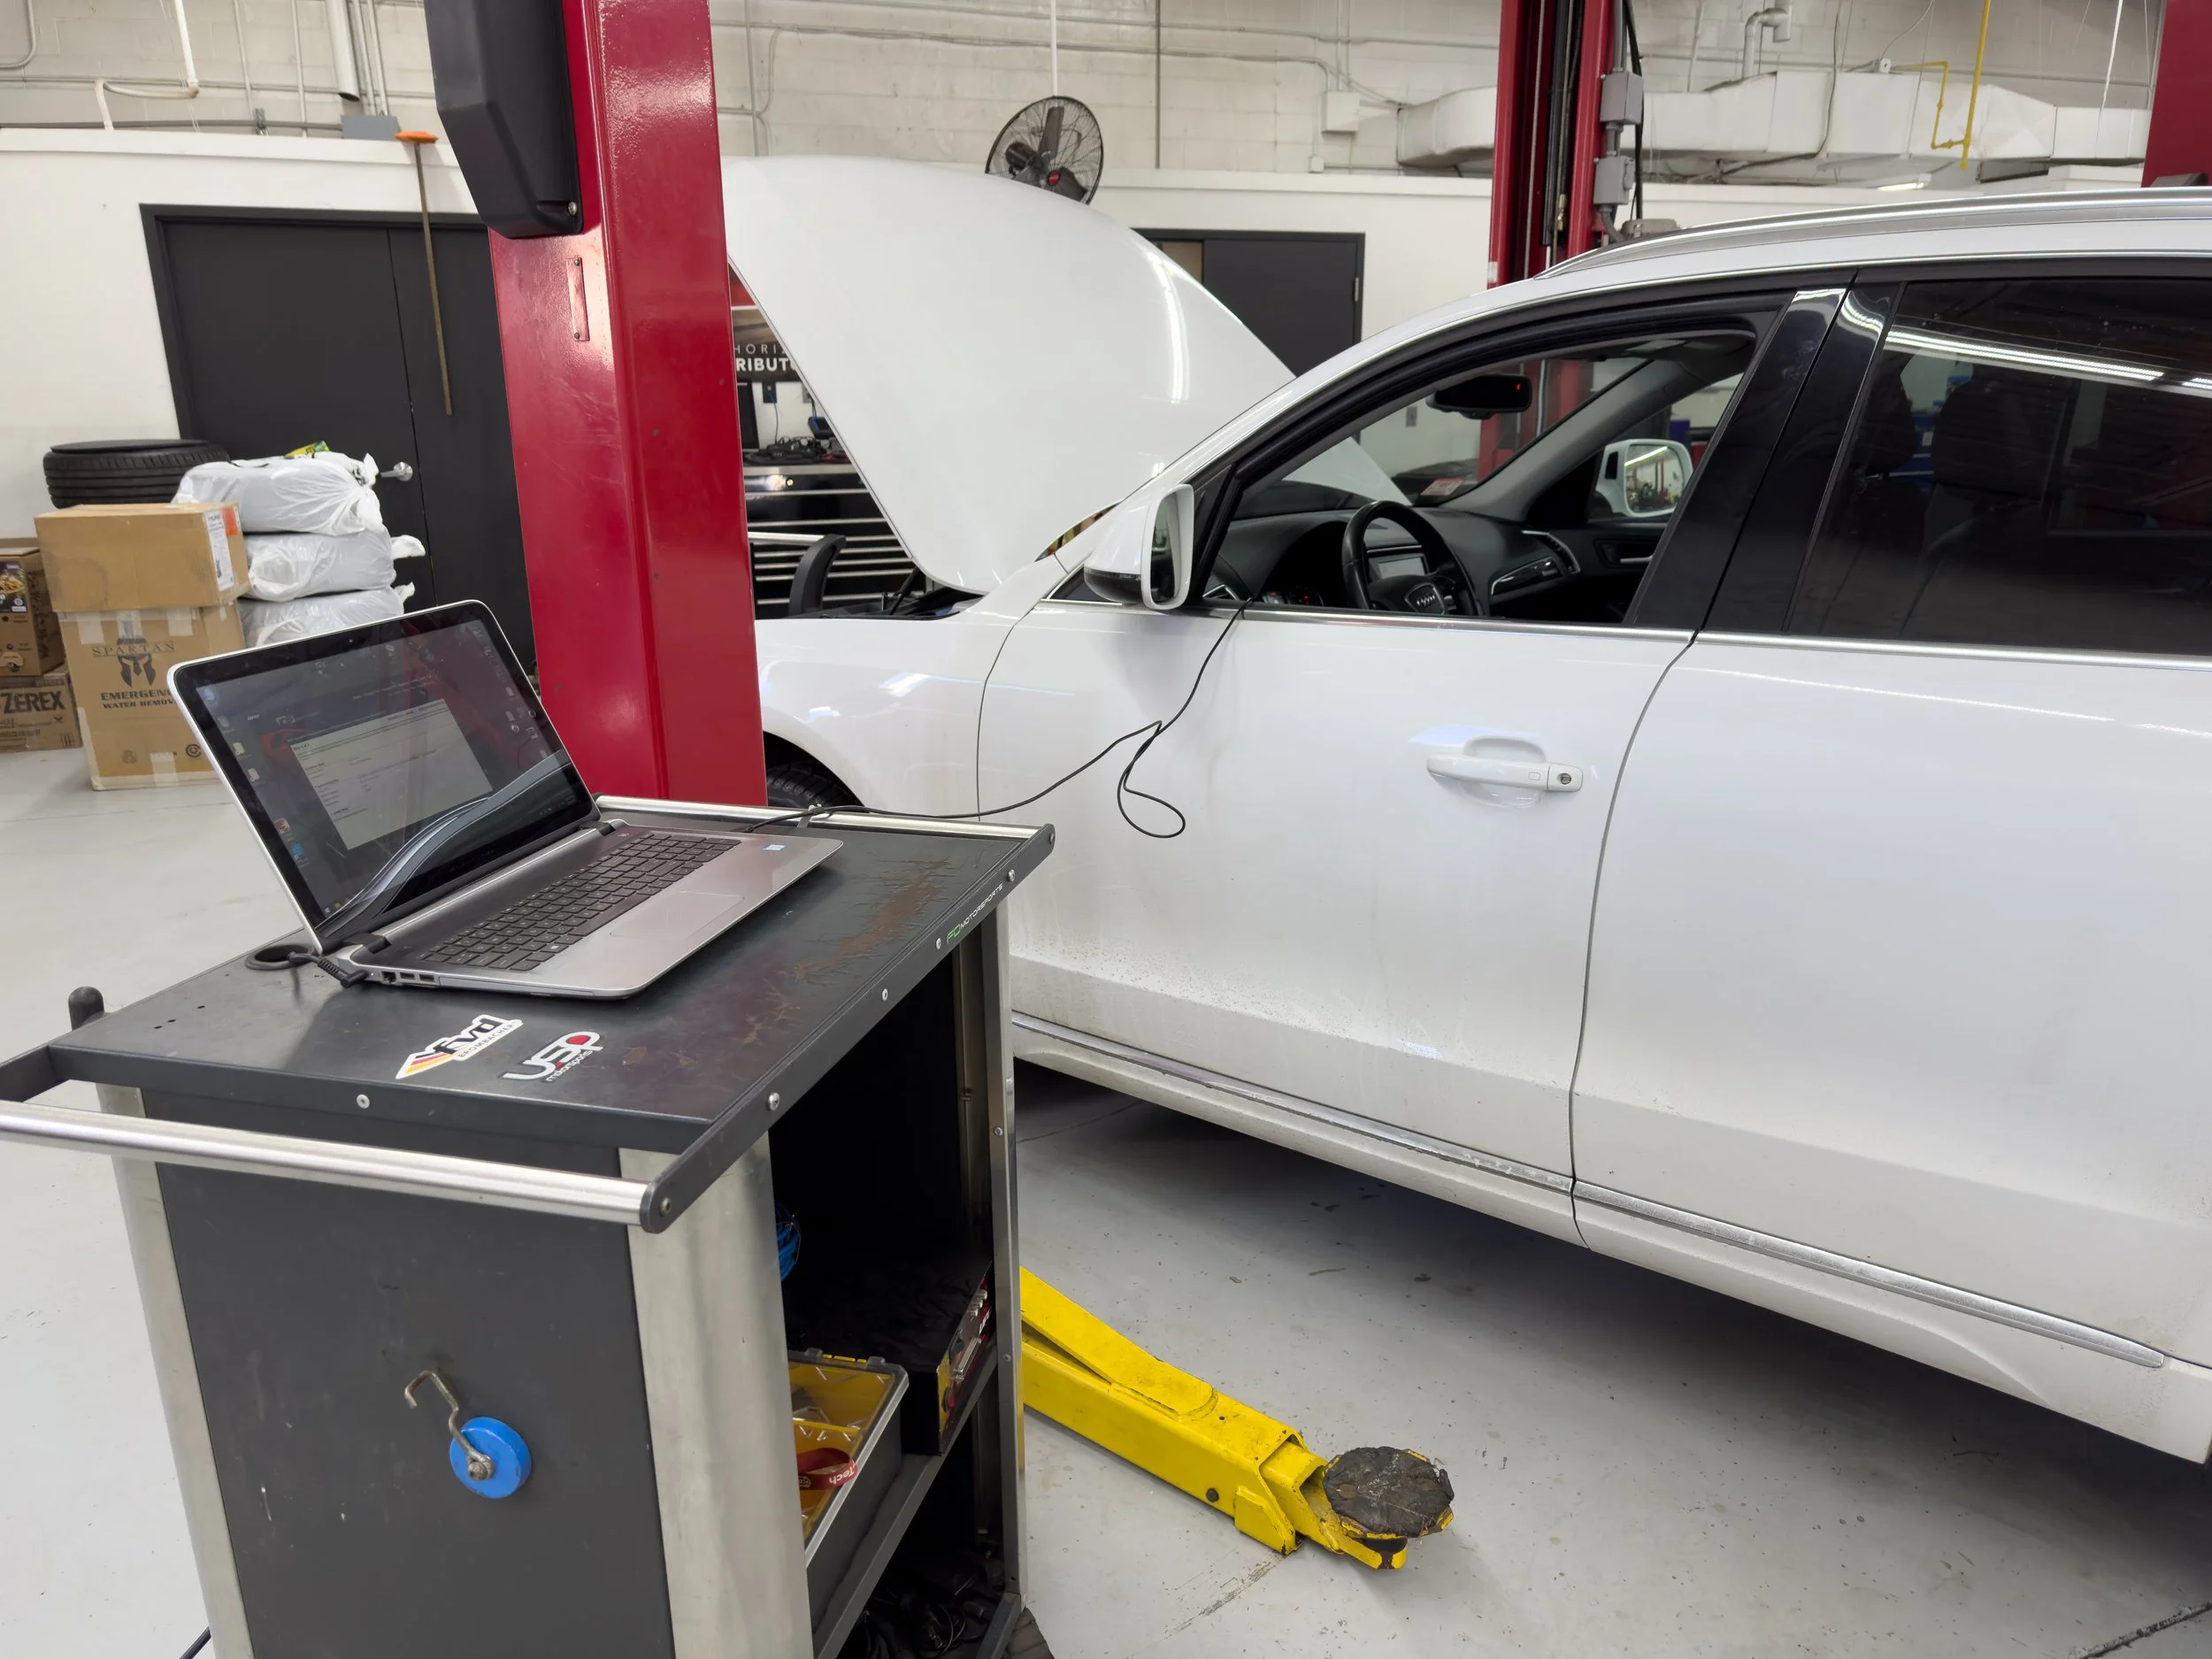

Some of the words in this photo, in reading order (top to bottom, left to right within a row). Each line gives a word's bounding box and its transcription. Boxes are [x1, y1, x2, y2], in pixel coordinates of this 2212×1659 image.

[92, 641, 175, 656] SPARTAN
[0, 691, 65, 714] ZEREX
[828, 1466, 855, 1485] Tech
